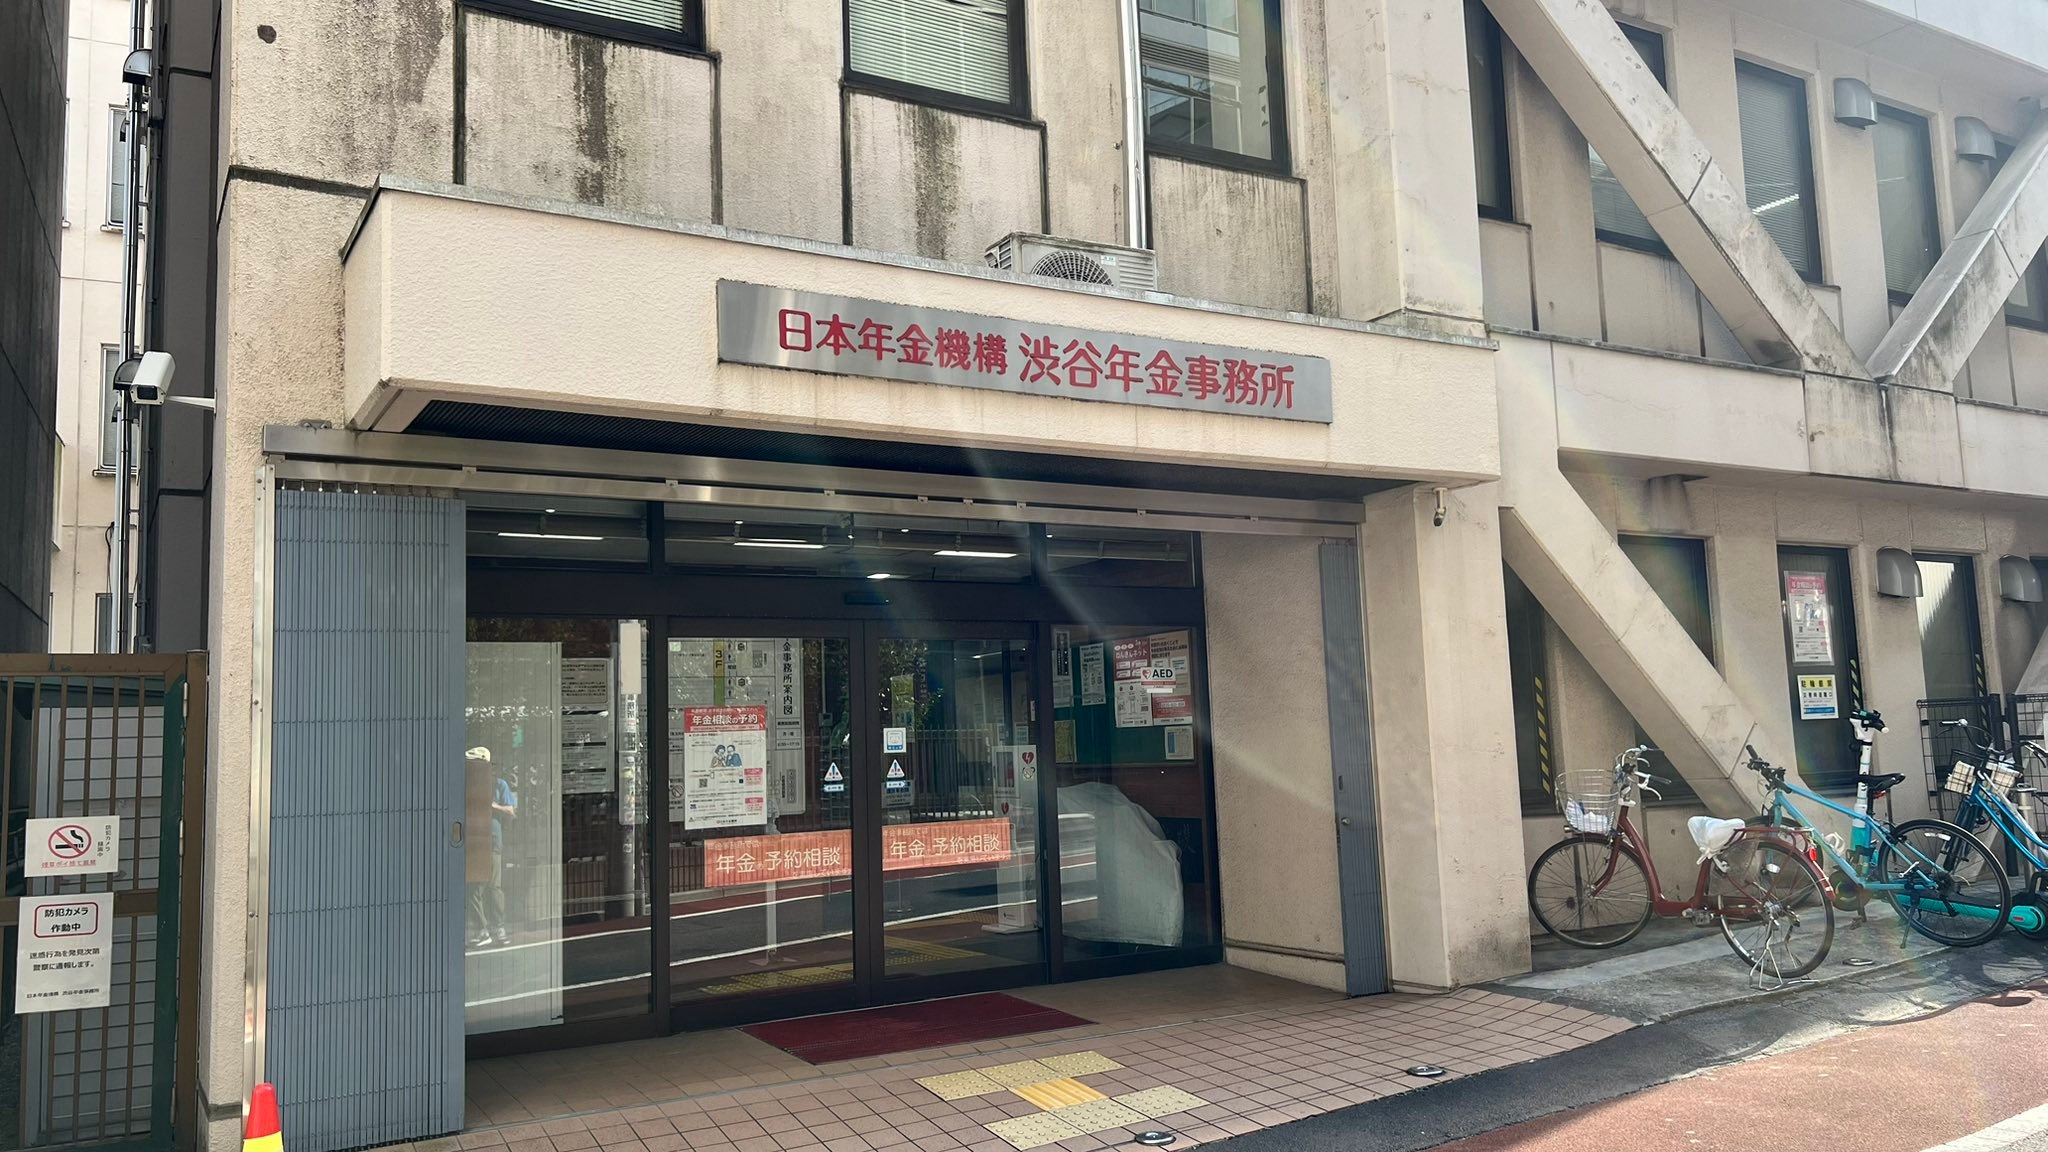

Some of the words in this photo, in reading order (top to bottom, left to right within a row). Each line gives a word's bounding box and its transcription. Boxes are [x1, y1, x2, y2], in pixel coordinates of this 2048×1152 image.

[778, 308, 1008, 375] 日本年金機構
[1018, 332, 1295, 410] 渋谷年金事務所
[782, 638, 793, 715] 金事務所案内図
[1152, 669, 1173, 678] AED
[692, 714, 758, 726] 年金相談の予約
[44, 907, 89, 918] 防犯カメラ
[51, 922, 81, 933] 作動中
